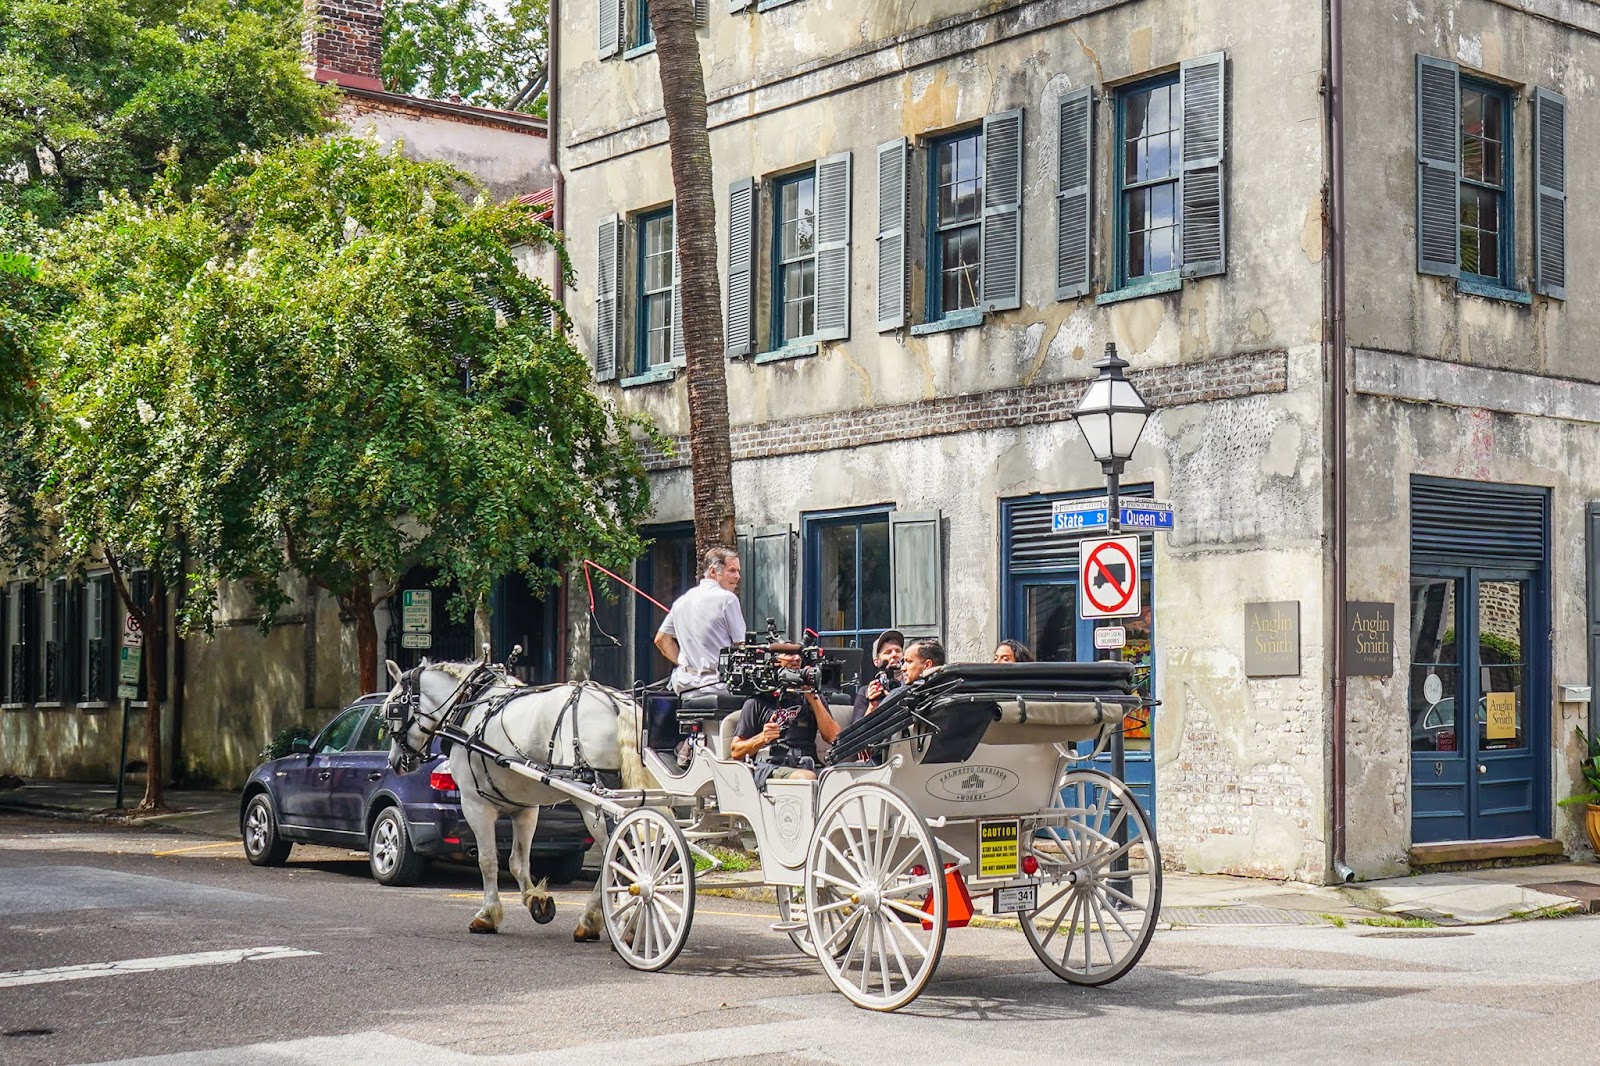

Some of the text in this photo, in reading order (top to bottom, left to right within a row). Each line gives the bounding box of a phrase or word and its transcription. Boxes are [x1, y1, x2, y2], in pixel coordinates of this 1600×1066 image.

[1057, 512, 1105, 529] State St
[1126, 510, 1167, 526] Queen St
[1250, 610, 1292, 640] Anglin
[1351, 611, 1390, 640] Anglin
[1255, 632, 1293, 654] Smith
[1355, 633, 1390, 654] Smith
[1489, 699, 1513, 717] Anglin
[1492, 713, 1513, 725] Smith
[940, 766, 1007, 783] PALMETTO CARRIAGE
[1435, 761, 1443, 776] 9
[982, 826, 1017, 838] CAUTION
[1018, 890, 1033, 901] 341
